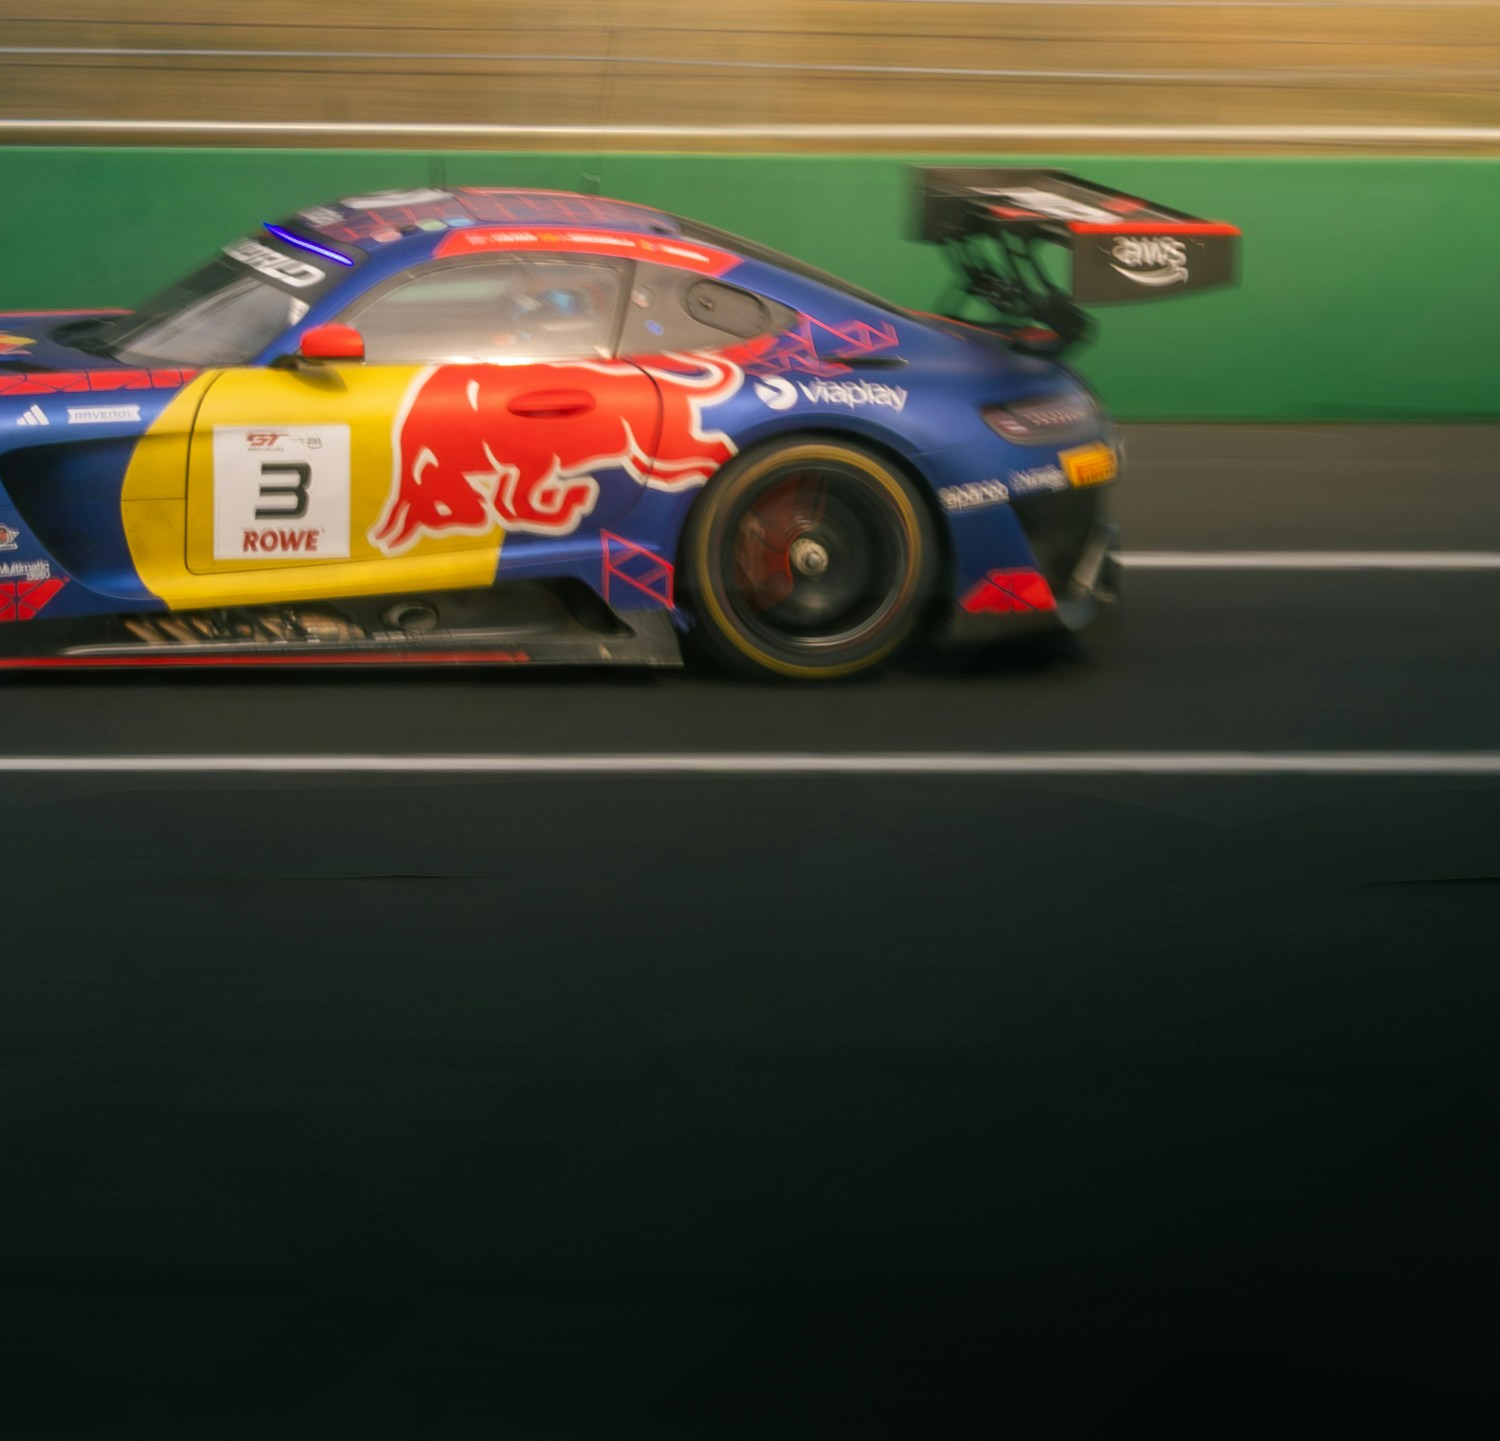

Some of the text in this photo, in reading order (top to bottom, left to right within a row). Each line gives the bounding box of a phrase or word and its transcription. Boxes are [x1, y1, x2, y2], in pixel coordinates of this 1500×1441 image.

[221, 237, 326, 287] ORLD
[1111, 236, 1187, 268] aws
[797, 377, 908, 411] viaplay
[254, 462, 312, 520] 3
[242, 528, 320, 552] ROWE
